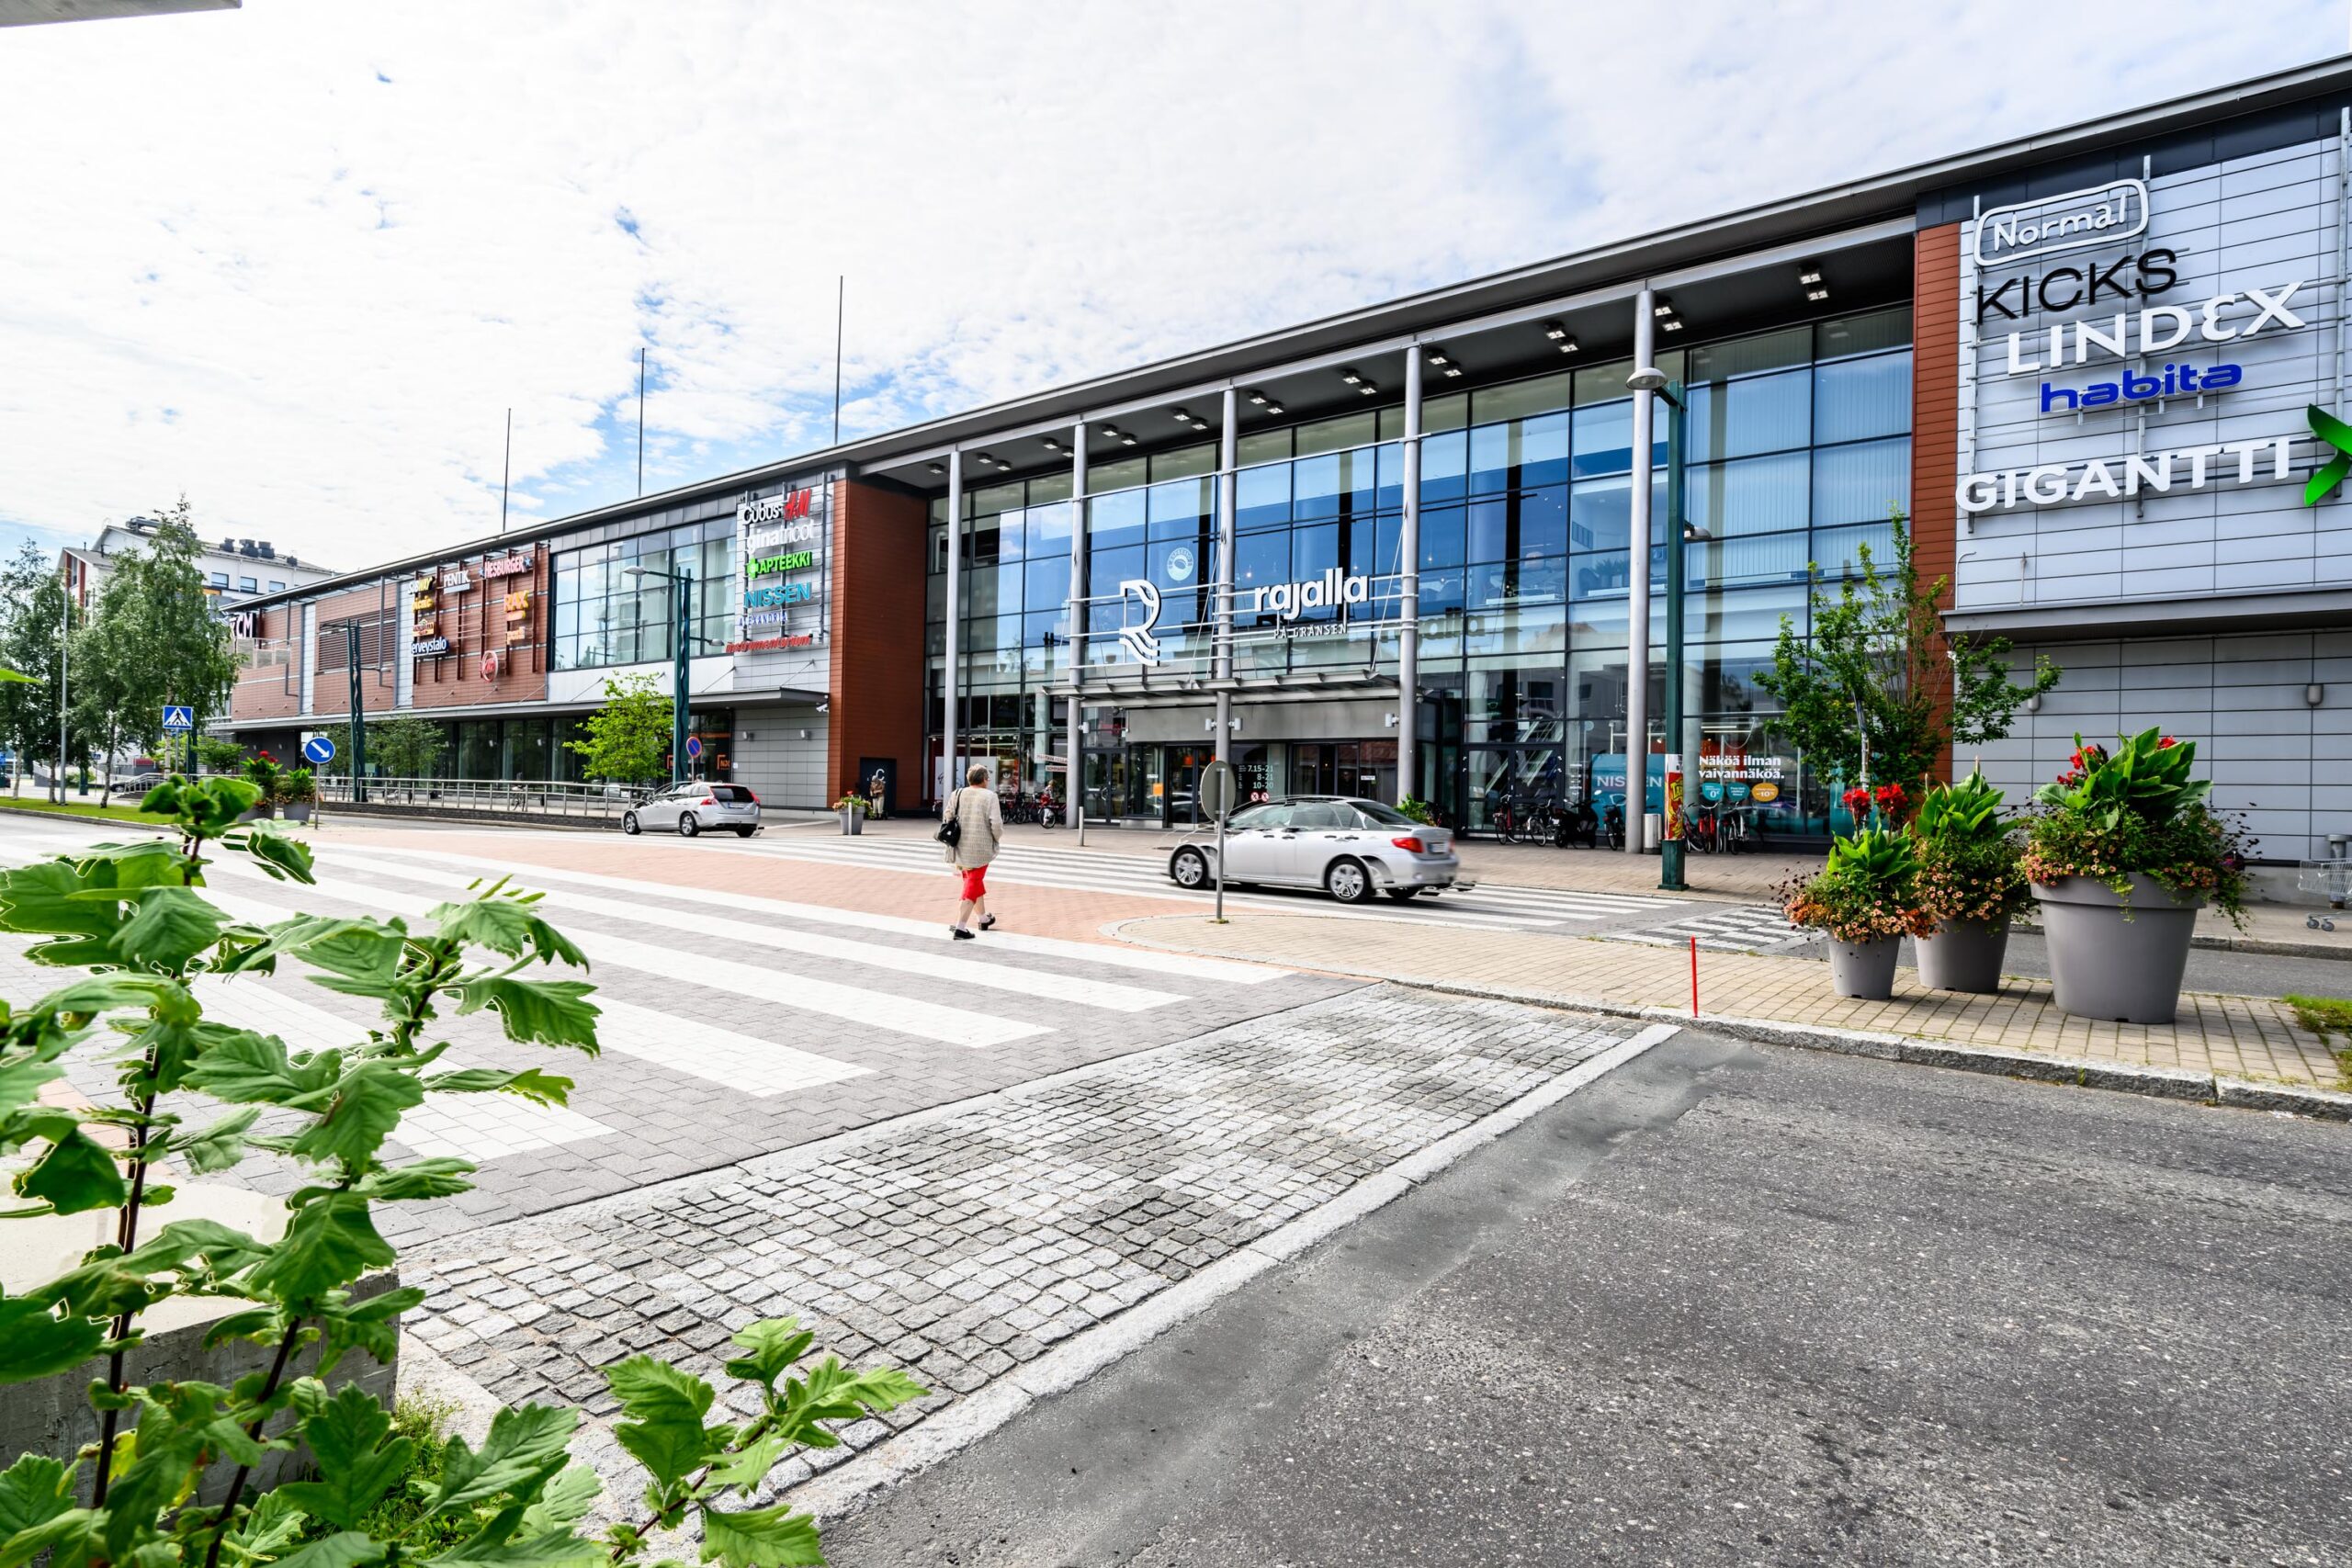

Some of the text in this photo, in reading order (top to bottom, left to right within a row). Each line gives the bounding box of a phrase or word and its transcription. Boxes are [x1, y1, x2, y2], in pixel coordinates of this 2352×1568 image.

[1993, 192, 2127, 253] Normal
[1976, 248, 2177, 325] KICKS
[2007, 281, 2307, 376] LINDEX
[2040, 363, 2244, 413] habita
[1954, 436, 2290, 513] GIGANTTI
[742, 502, 781, 525] Cubus
[484, 555, 526, 579] HESBURGER
[758, 550, 813, 575] APTEEKKI
[503, 590, 530, 612] RAX
[742, 581, 812, 609] NISSEN
[1254, 567, 1369, 620] rajalla
[1293, 623, 1347, 637] GRÄNSEN
[1698, 755, 1781, 766] Näköä ilman
[1698, 769, 1785, 780] vaivannäköä.
